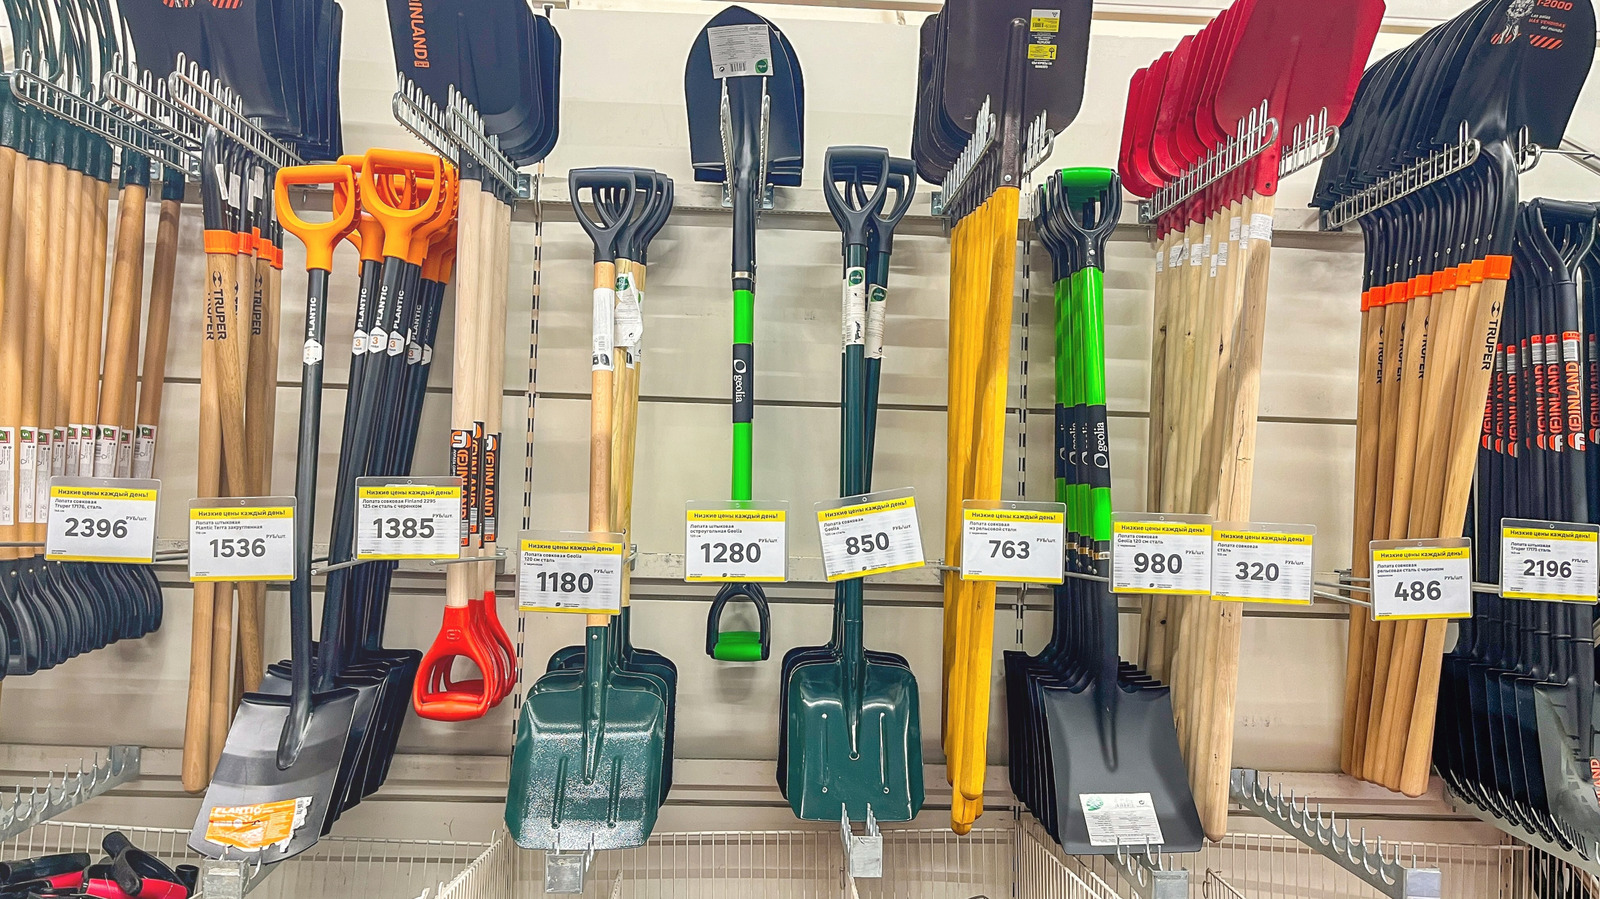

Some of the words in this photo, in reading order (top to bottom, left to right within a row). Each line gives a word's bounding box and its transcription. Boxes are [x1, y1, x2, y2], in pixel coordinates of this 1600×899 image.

[408, 0, 428, 60] INLAND
[214, 288, 226, 340] TRUPER
[252, 290, 262, 335] TRUPER
[308, 297, 316, 336] PLANTIC
[358, 288, 367, 328] PLANTIC
[376, 286, 388, 326] PLANTIC
[394, 290, 404, 329] PLANTIC
[412, 304, 422, 340] PLANTIC
[1481, 319, 1498, 370] TRUPER
[734, 375, 745, 402] geolia
[1566, 362, 1581, 432] FINLAND
[1094, 422, 1108, 452] geolia
[65, 518, 128, 538] 2396
[373, 518, 434, 538] 1385
[210, 538, 266, 557] 1536
[701, 543, 761, 563] 1280
[846, 532, 889, 555] 850
[989, 540, 1030, 559] 763
[1134, 553, 1182, 574] 980
[1235, 562, 1279, 581] 320
[1524, 559, 1572, 578] 2196
[537, 572, 593, 593] 1180
[1395, 581, 1441, 601] 486
